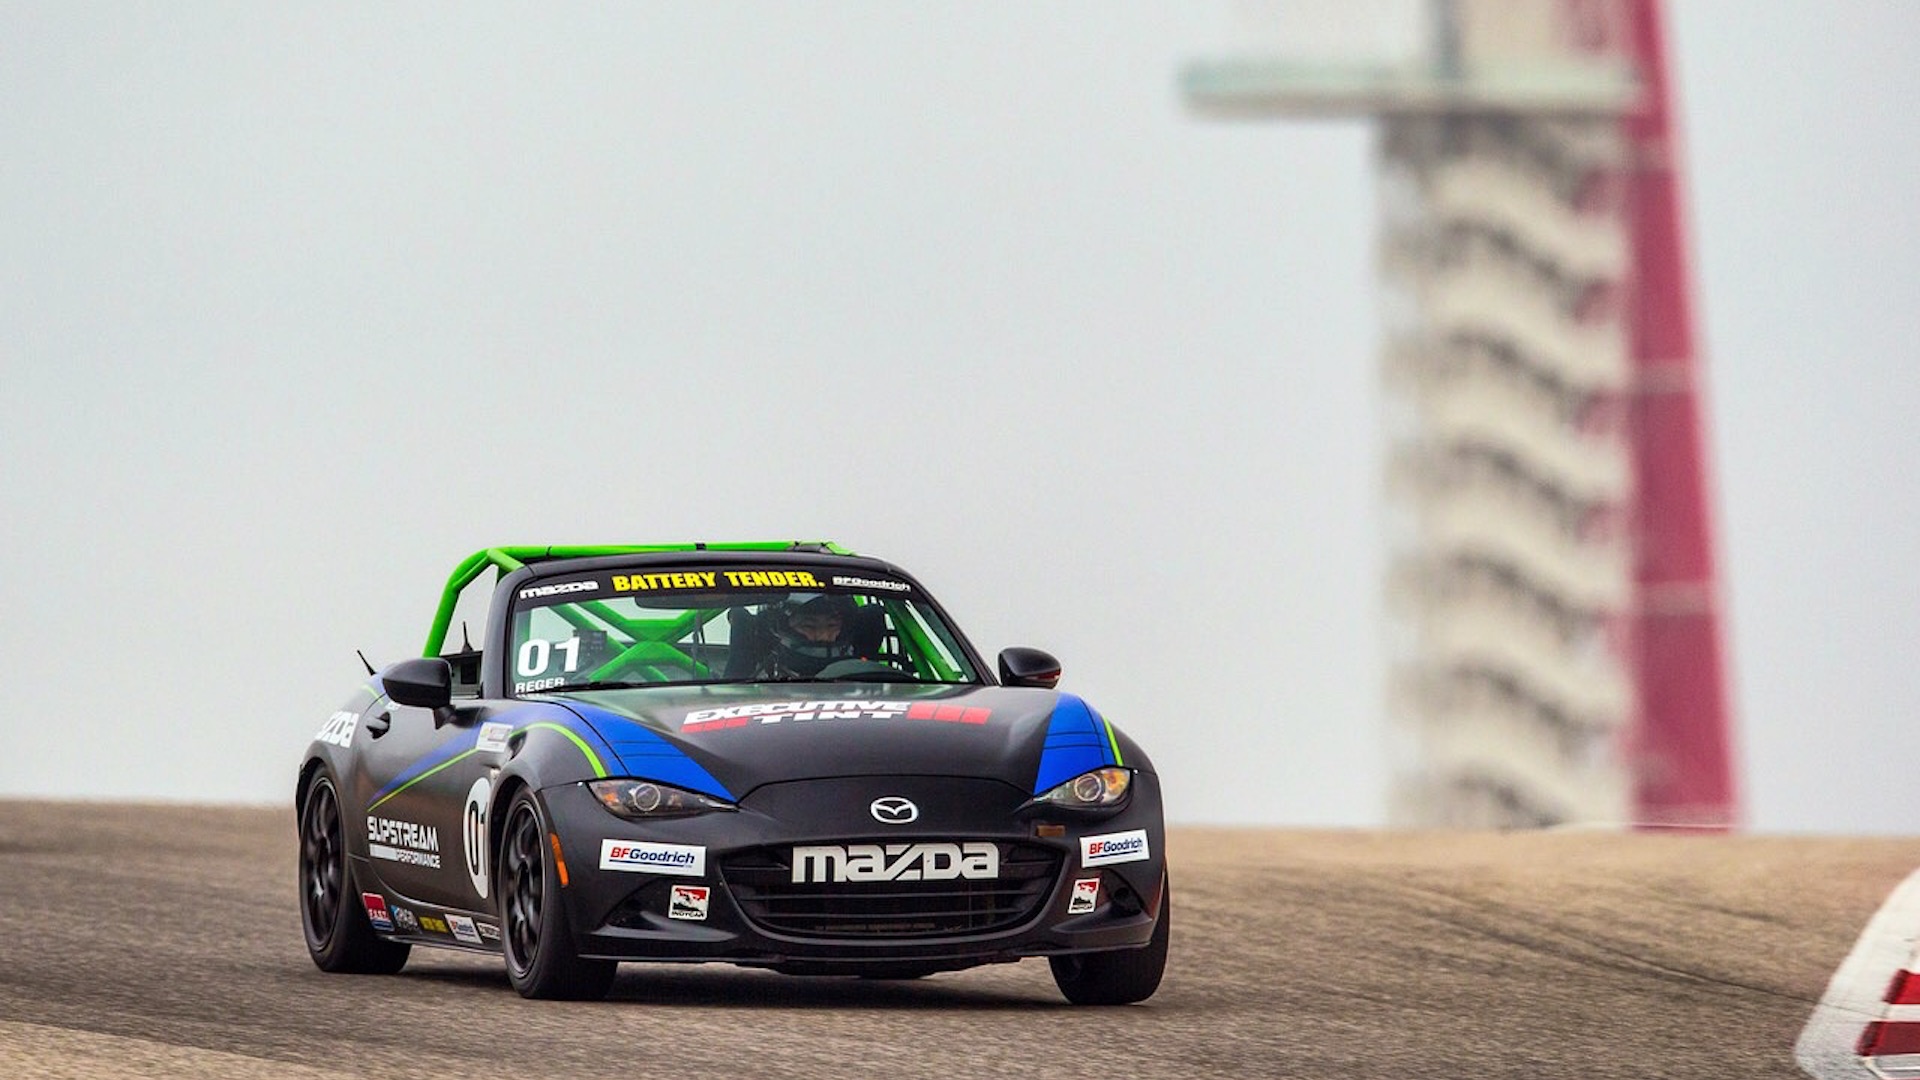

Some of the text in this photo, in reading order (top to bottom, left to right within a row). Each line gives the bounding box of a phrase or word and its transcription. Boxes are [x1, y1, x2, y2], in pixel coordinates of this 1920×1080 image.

[612, 572, 717, 592] BATTERY
[517, 637, 580, 677] 01
[515, 677, 565, 694] REGER
[684, 701, 911, 726] EXECUTIVE
[754, 710, 905, 725] TINT
[366, 815, 439, 852] SLIPSTREAM
[609, 847, 695, 864] BFGoodrich
[1088, 838, 1143, 855] BFGoodrich
